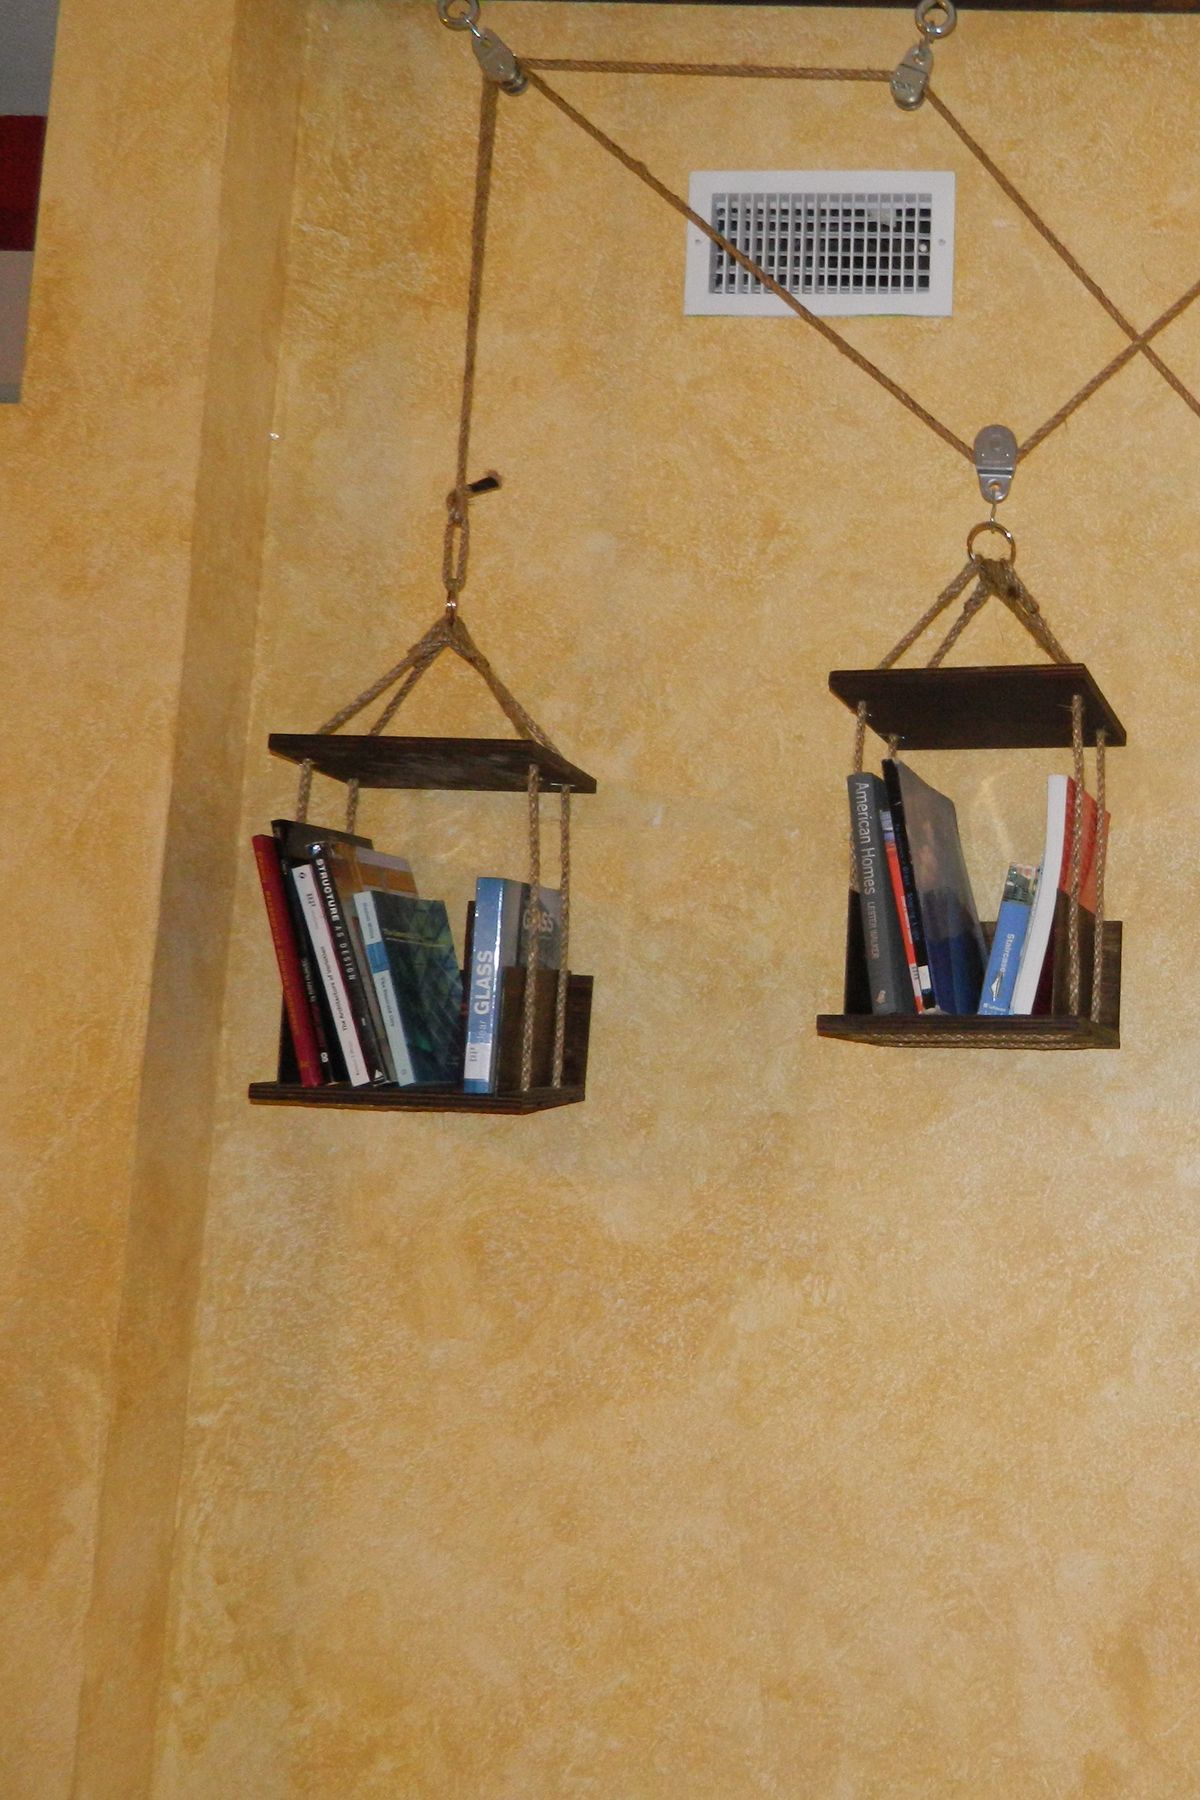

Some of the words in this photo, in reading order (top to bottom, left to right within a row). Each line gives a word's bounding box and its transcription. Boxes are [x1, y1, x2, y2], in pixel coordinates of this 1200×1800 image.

[855, 782, 873, 844] American
[860, 847, 876, 895] Homes
[316, 858, 339, 921] STRUCTURE
[340, 943, 356, 981] DESIGN
[868, 901, 878, 927] LESTER
[474, 950, 494, 1015] GLASS
